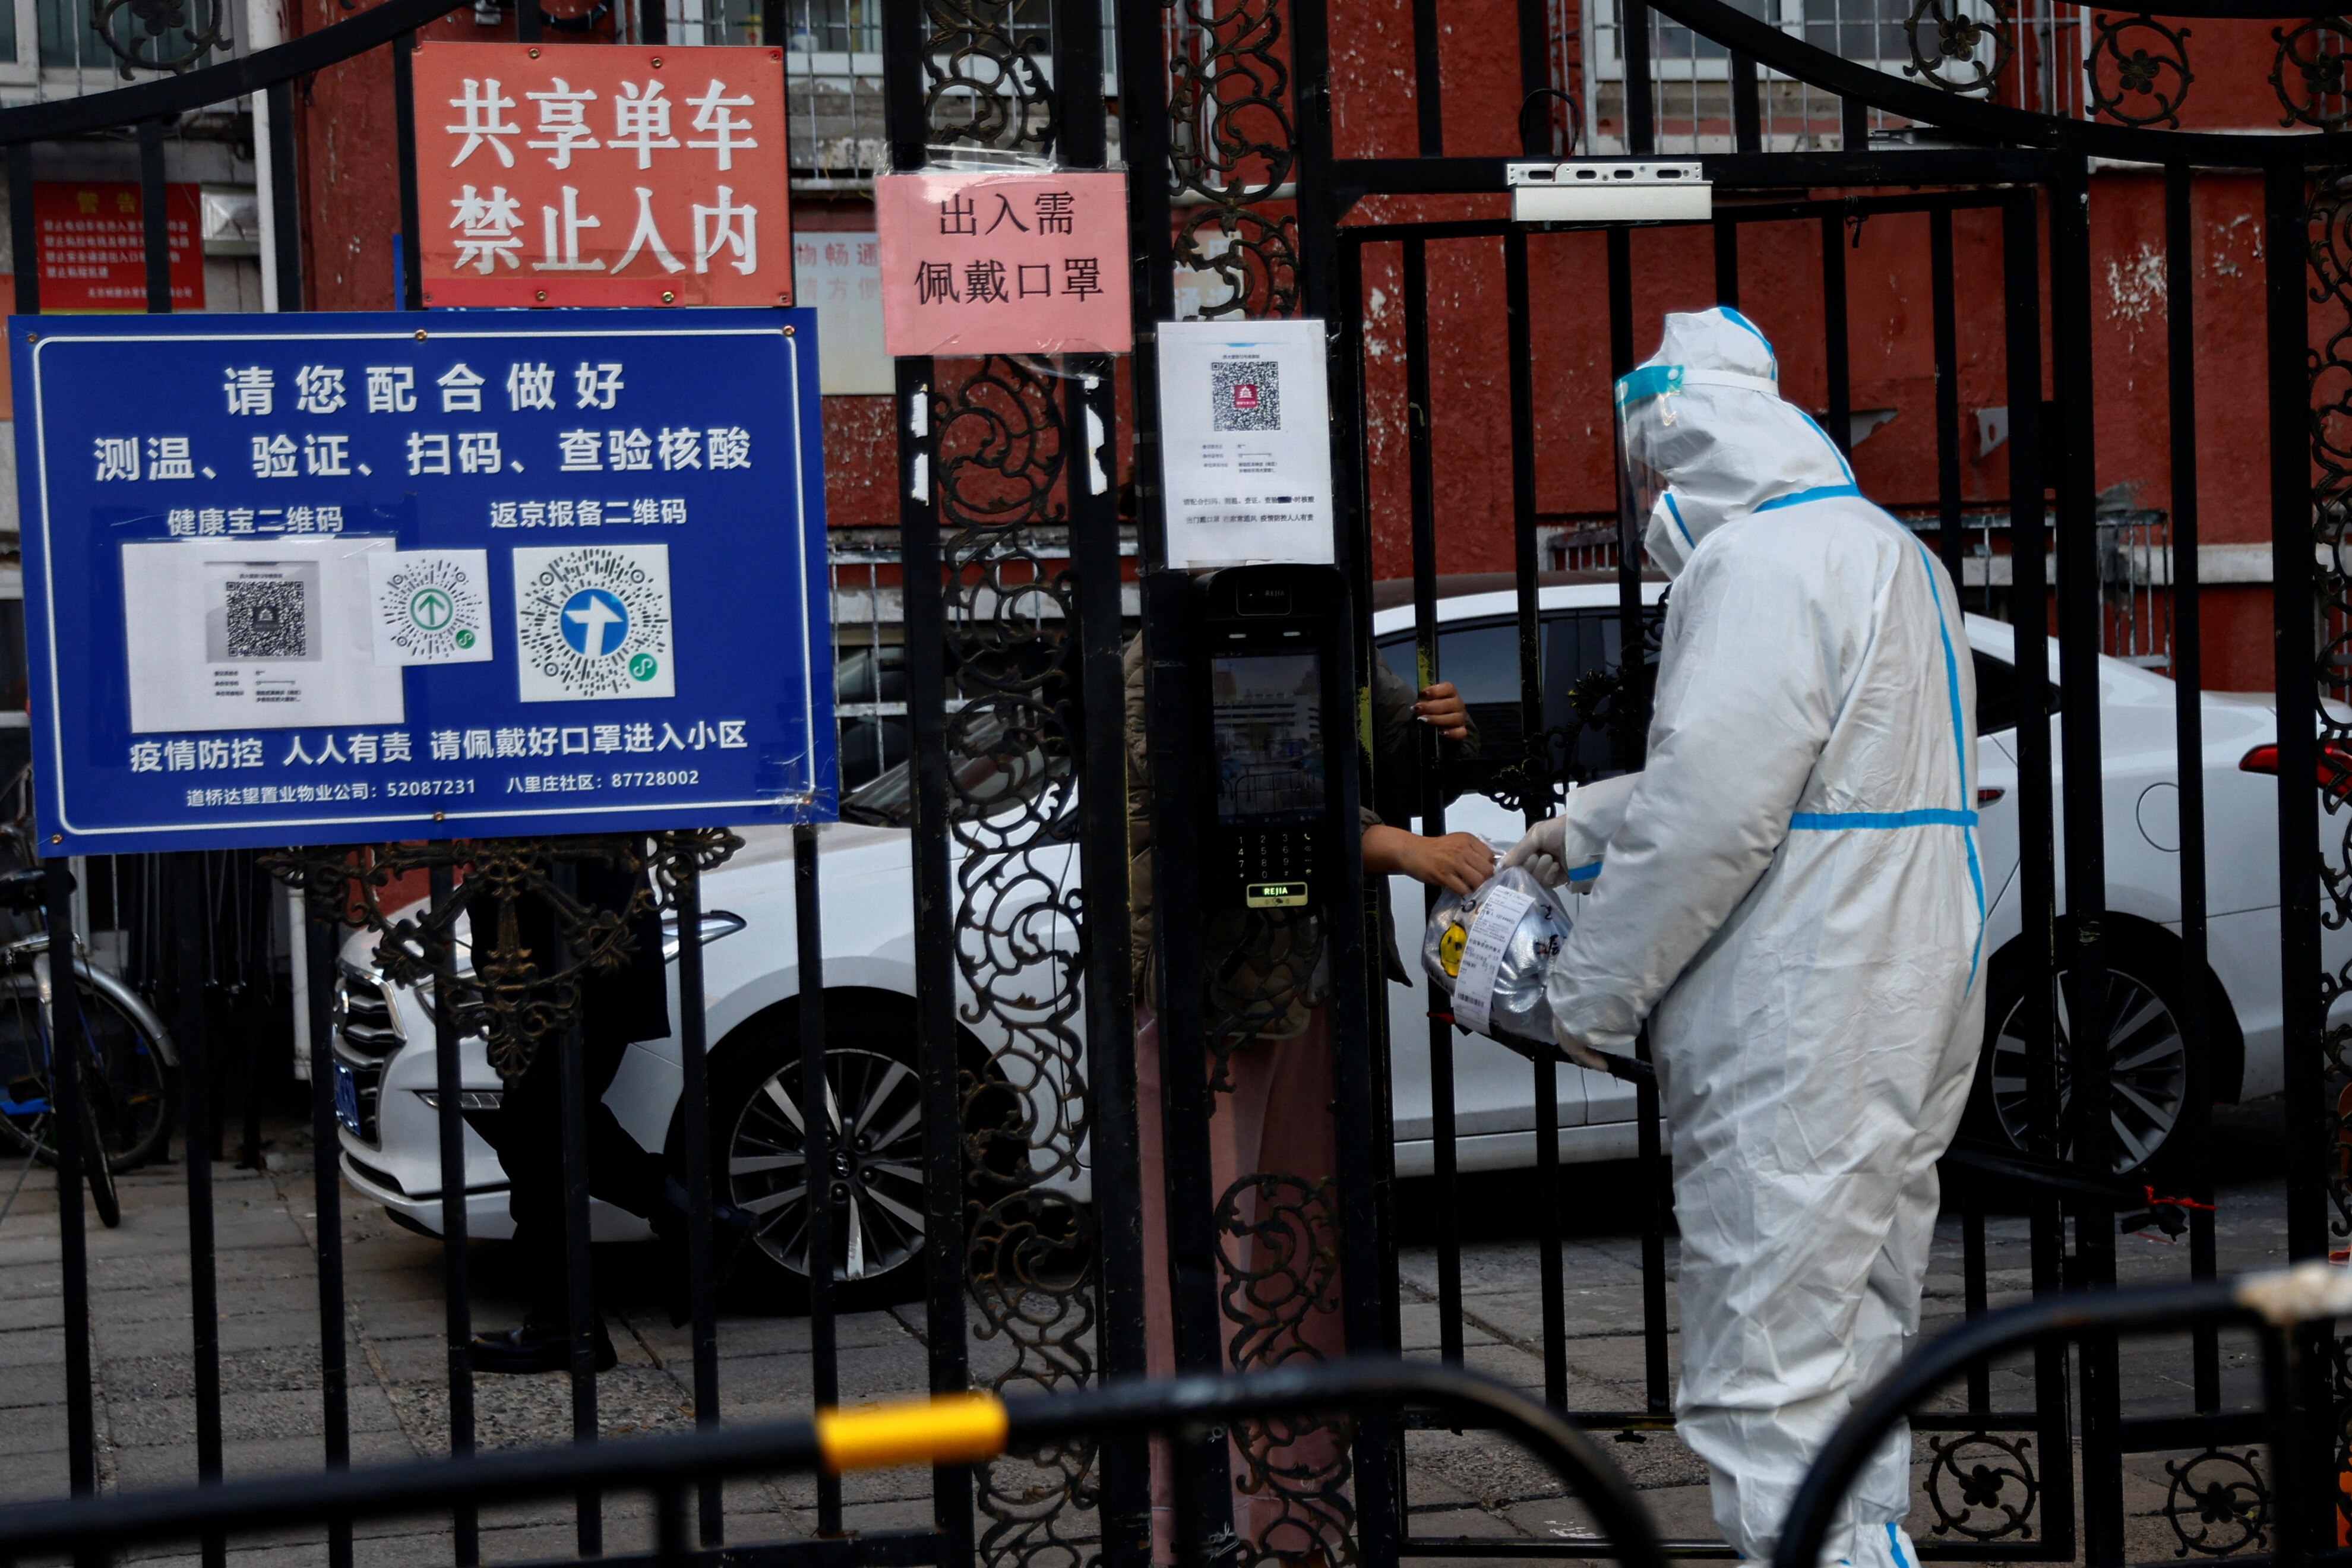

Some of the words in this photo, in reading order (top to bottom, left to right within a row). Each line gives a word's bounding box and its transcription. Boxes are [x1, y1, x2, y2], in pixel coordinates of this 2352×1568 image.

[445, 77, 758, 171] 共享单车
[940, 191, 1076, 237] 出入需
[913, 257, 1105, 305] 佩戴口罩
[223, 362, 625, 416] 请您配合做好
[93, 426, 753, 482] 测温、验证、扫码、查验核酸
[167, 506, 343, 536] 健康宝二维码
[491, 498, 687, 529] 返京报备二维码
[129, 738, 264, 774] 疫情防控
[283, 732, 413, 766] 人人有责
[431, 720, 748, 761] 请佩戴好口罩进入小区
[1238, 836, 1243, 844] 1
[1260, 834, 1266, 843] 2
[1282, 833, 1288, 842] 3
[1260, 846, 1267, 855] 5
[1282, 846, 1289, 854] 6
[1238, 859, 1244, 868] 7
[1261, 858, 1267, 867] 8
[1283, 857, 1289, 866] 9
[1262, 870, 1267, 879] 0
[1263, 886, 1288, 896] REJIA
